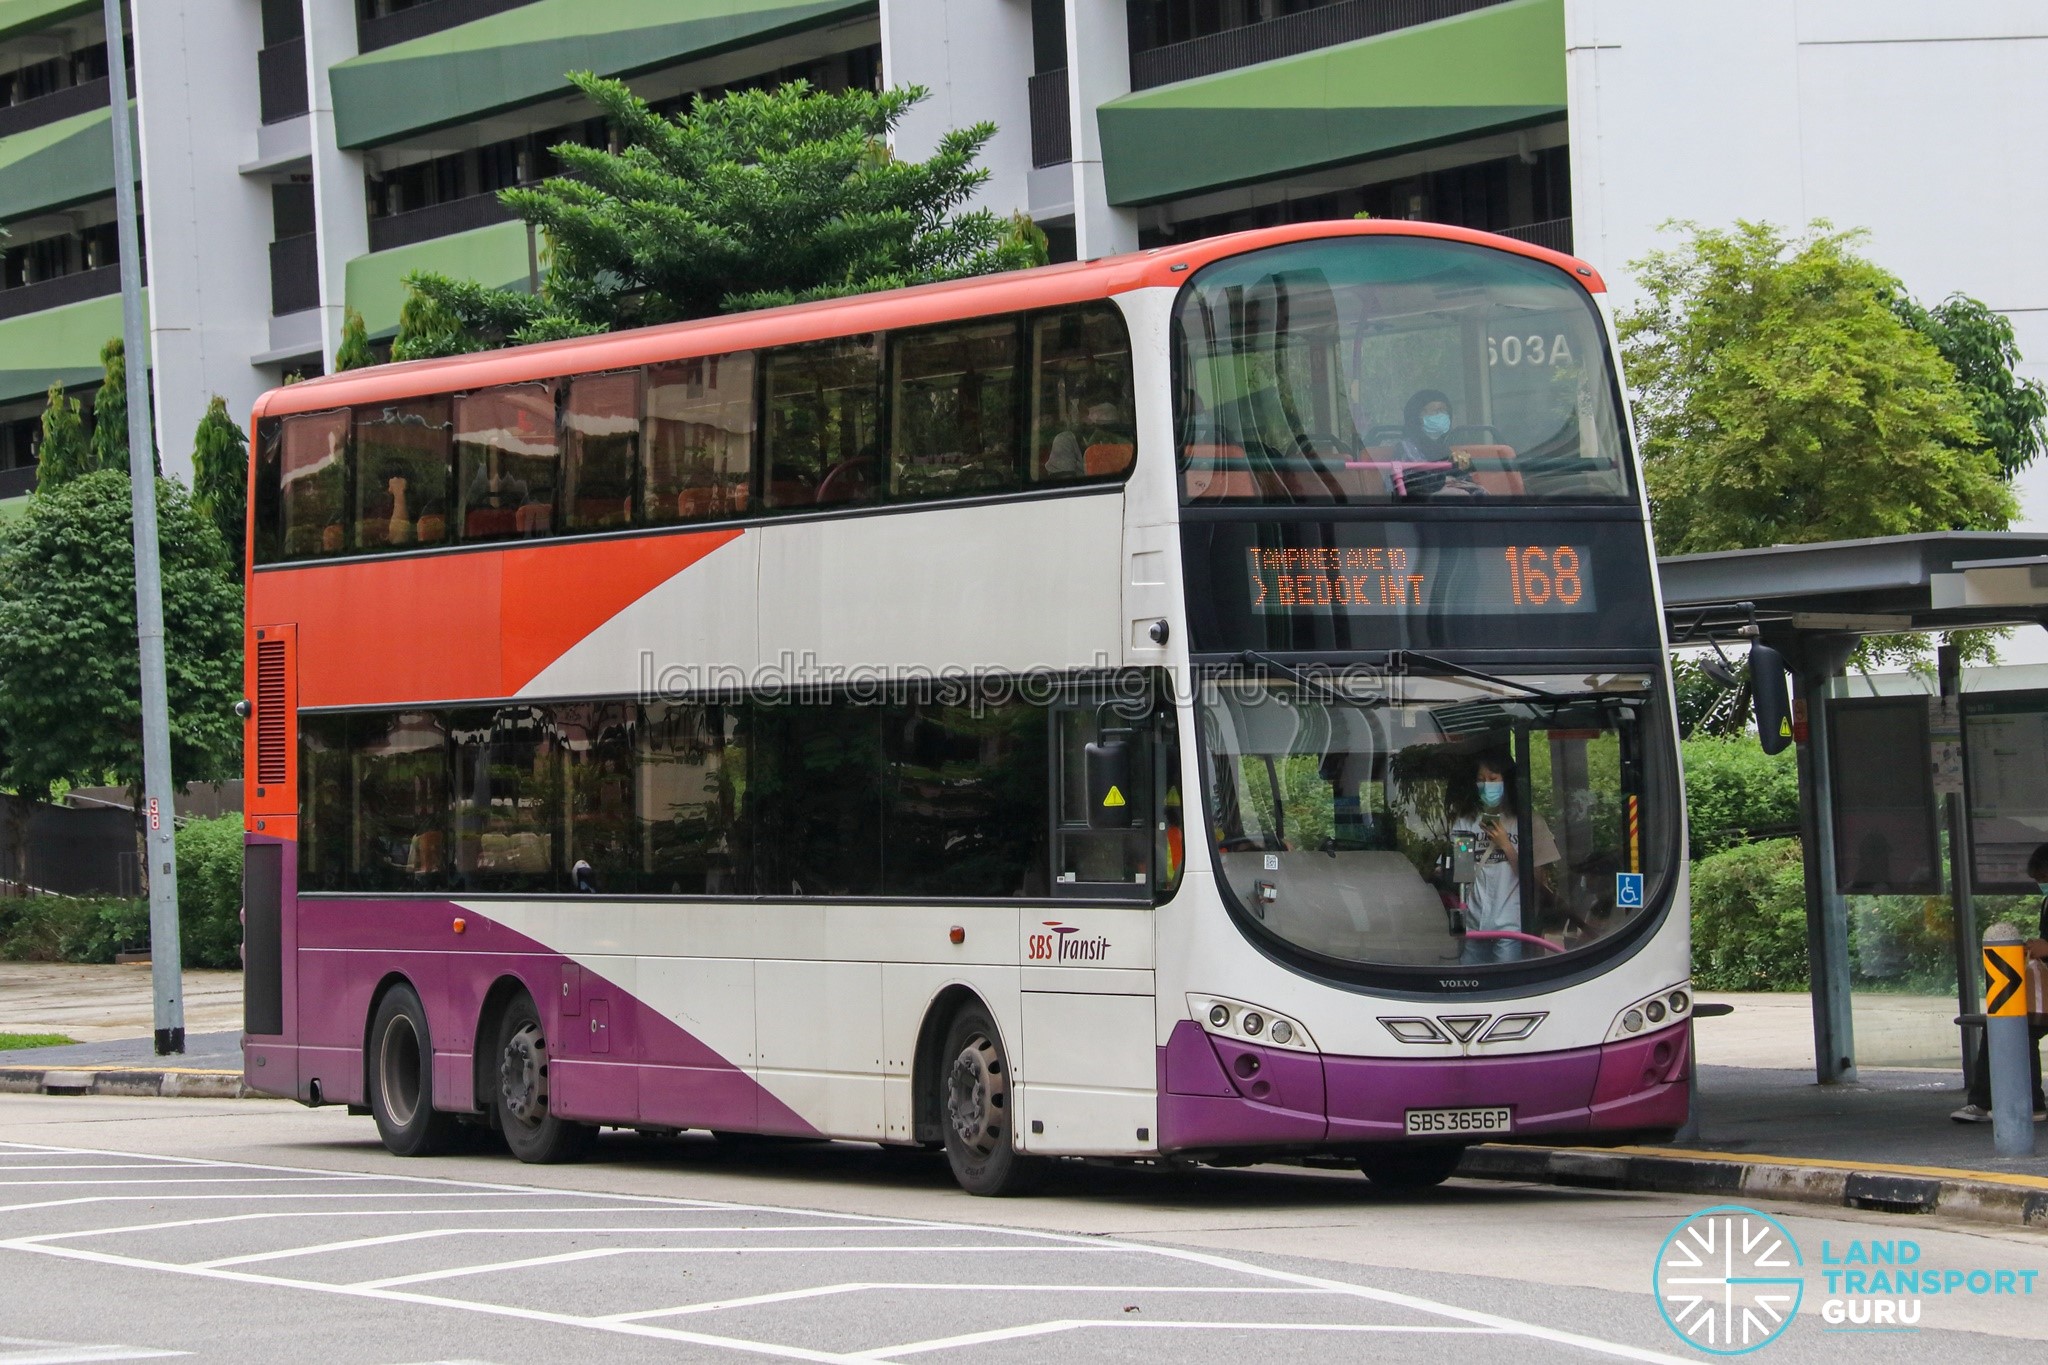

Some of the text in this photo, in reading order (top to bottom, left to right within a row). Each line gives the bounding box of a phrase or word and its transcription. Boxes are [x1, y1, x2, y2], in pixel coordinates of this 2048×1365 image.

[1251, 548, 1407, 570] TAMPINES AVE 10
[1505, 545, 1583, 605] 168
[1278, 575, 1425, 605] BEDOK INT
[1028, 927, 1112, 964] SBS Transit
[1439, 979, 1479, 988] VOLVO
[1409, 1110, 1508, 1132] SBS3656P
